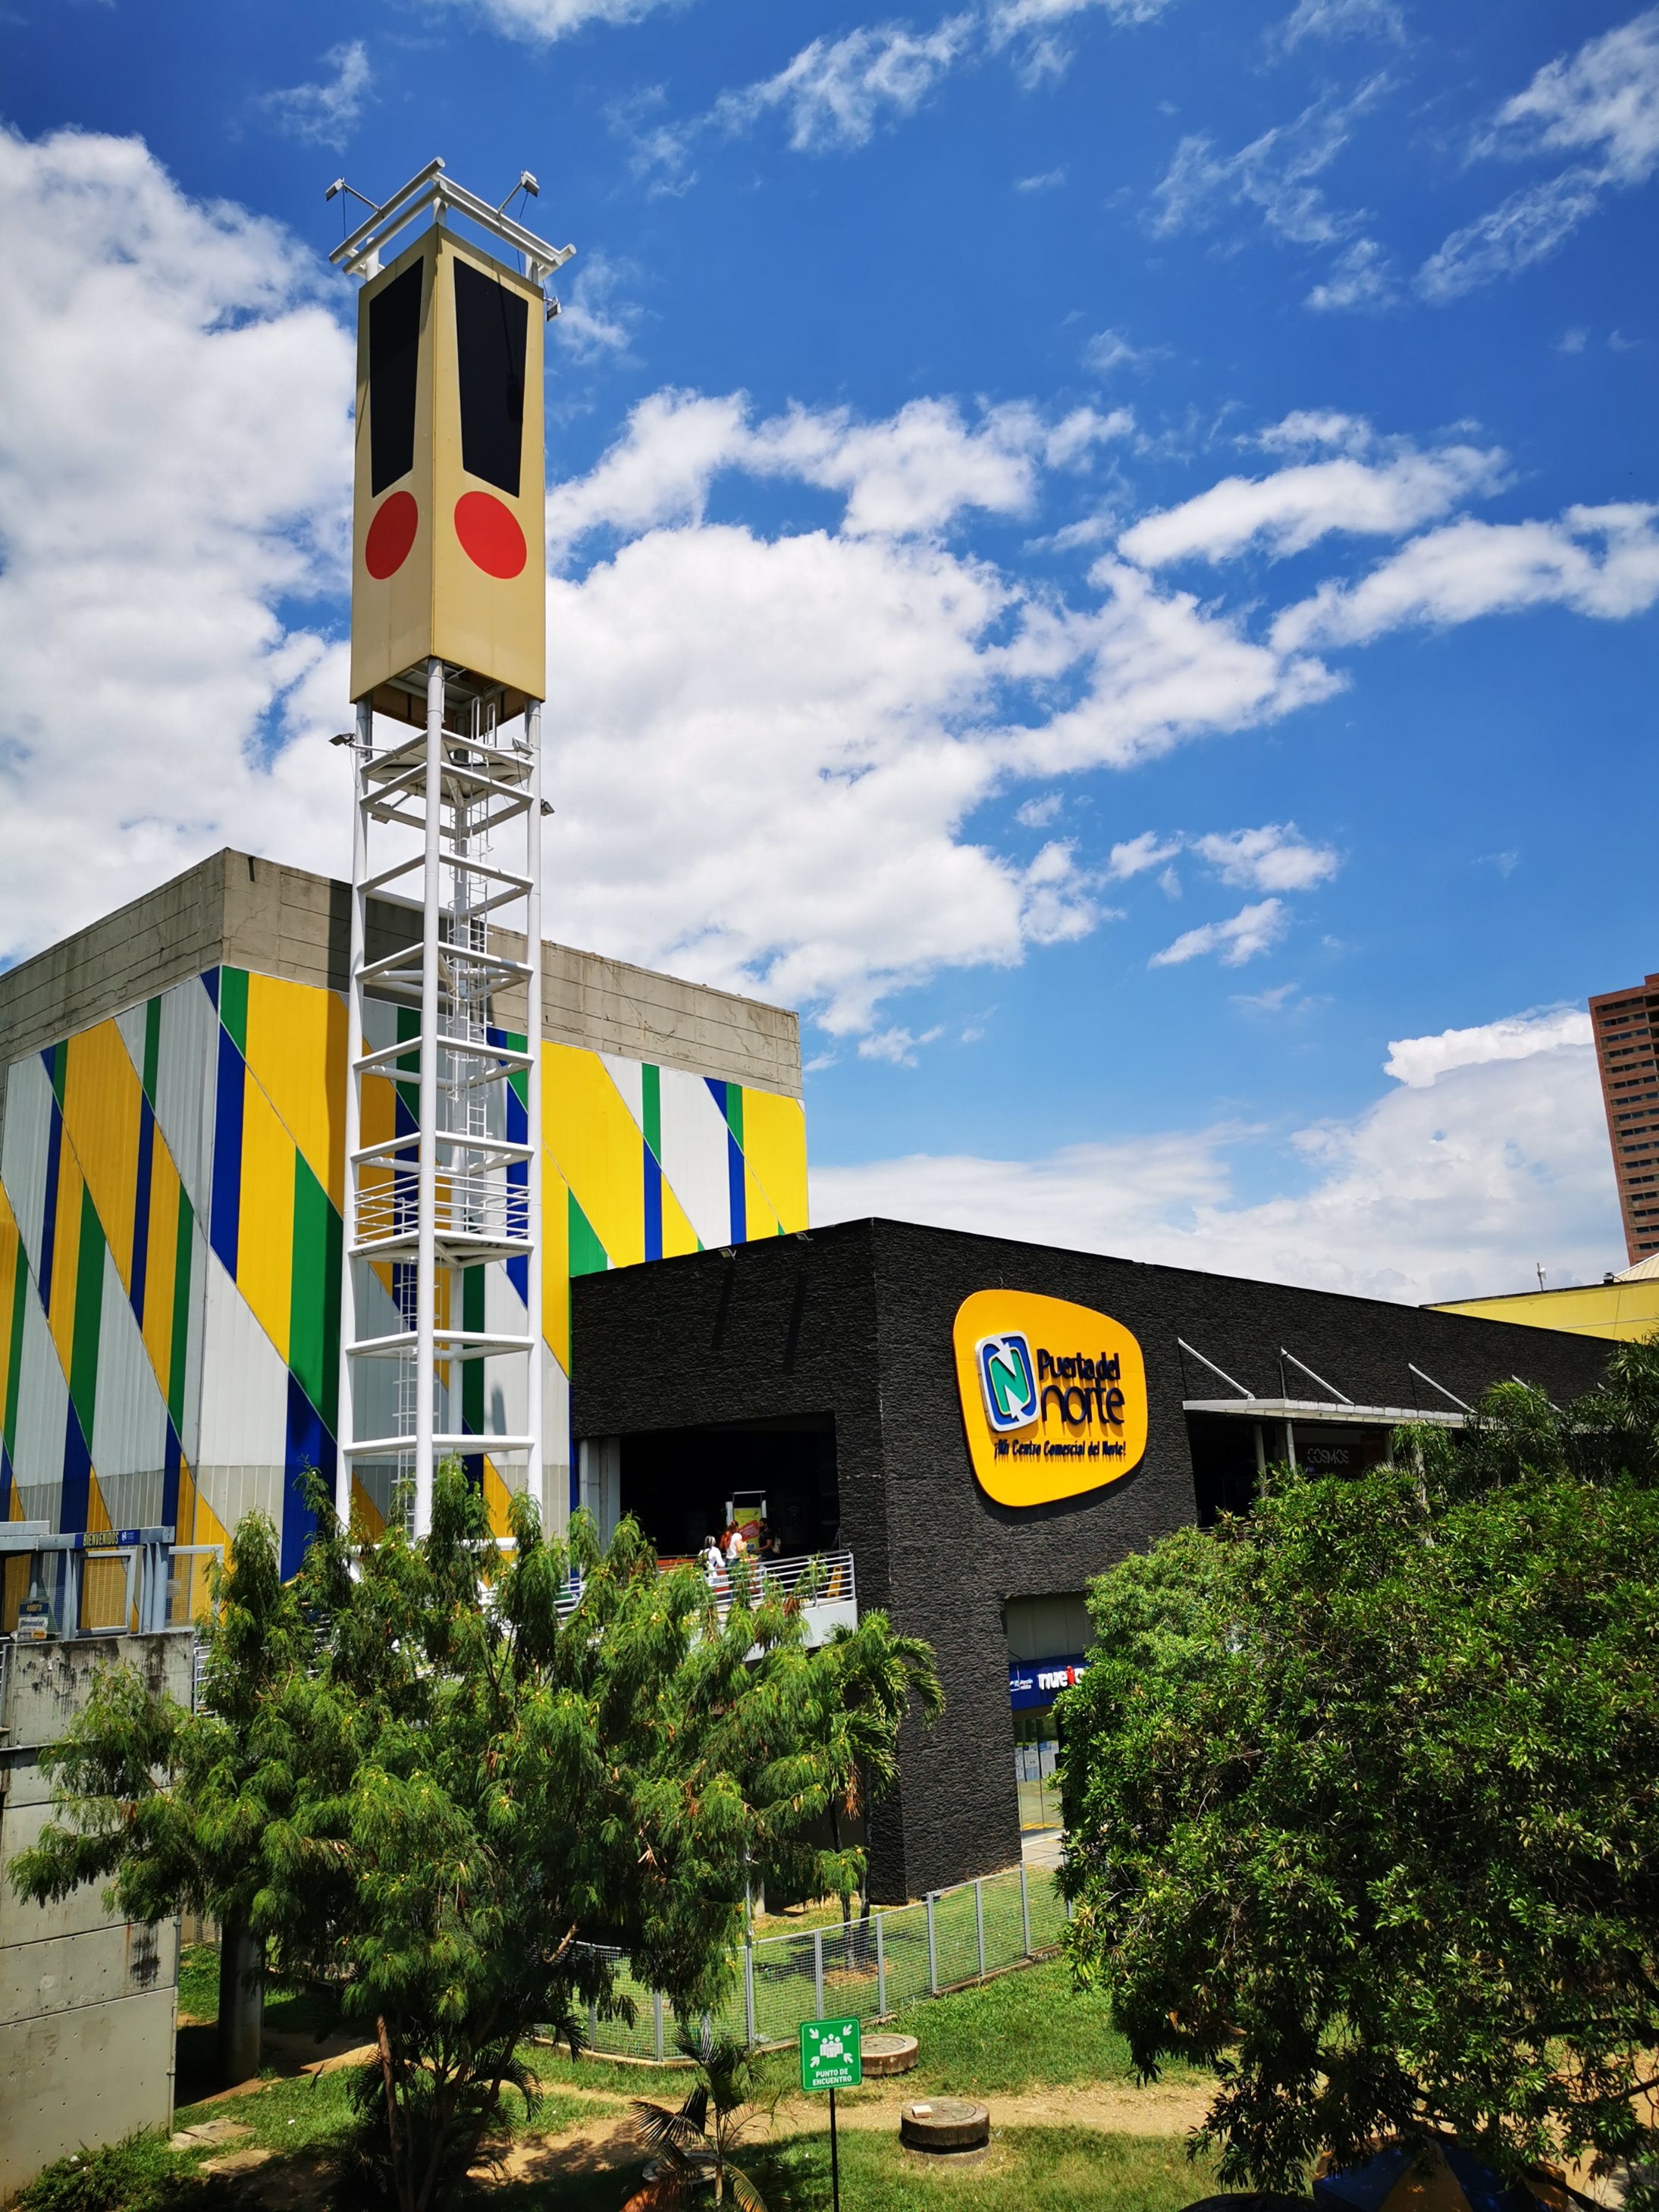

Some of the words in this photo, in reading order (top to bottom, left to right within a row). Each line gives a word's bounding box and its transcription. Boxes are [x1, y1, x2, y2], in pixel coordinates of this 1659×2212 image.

[1096, 1352, 1121, 1381] del
[1041, 1378, 1124, 1424] norte
[1012, 1440, 1041, 1456] Centro
[1043, 1440, 1085, 1456] Comercial
[1088, 1441, 1099, 1455] del
[1307, 1448, 1349, 1464] COSMOS
[83, 1531, 119, 1546] BIENVENIDOS
[812, 2075, 852, 2086] ENCUENTRO
[815, 2069, 839, 2078] PUNTO
